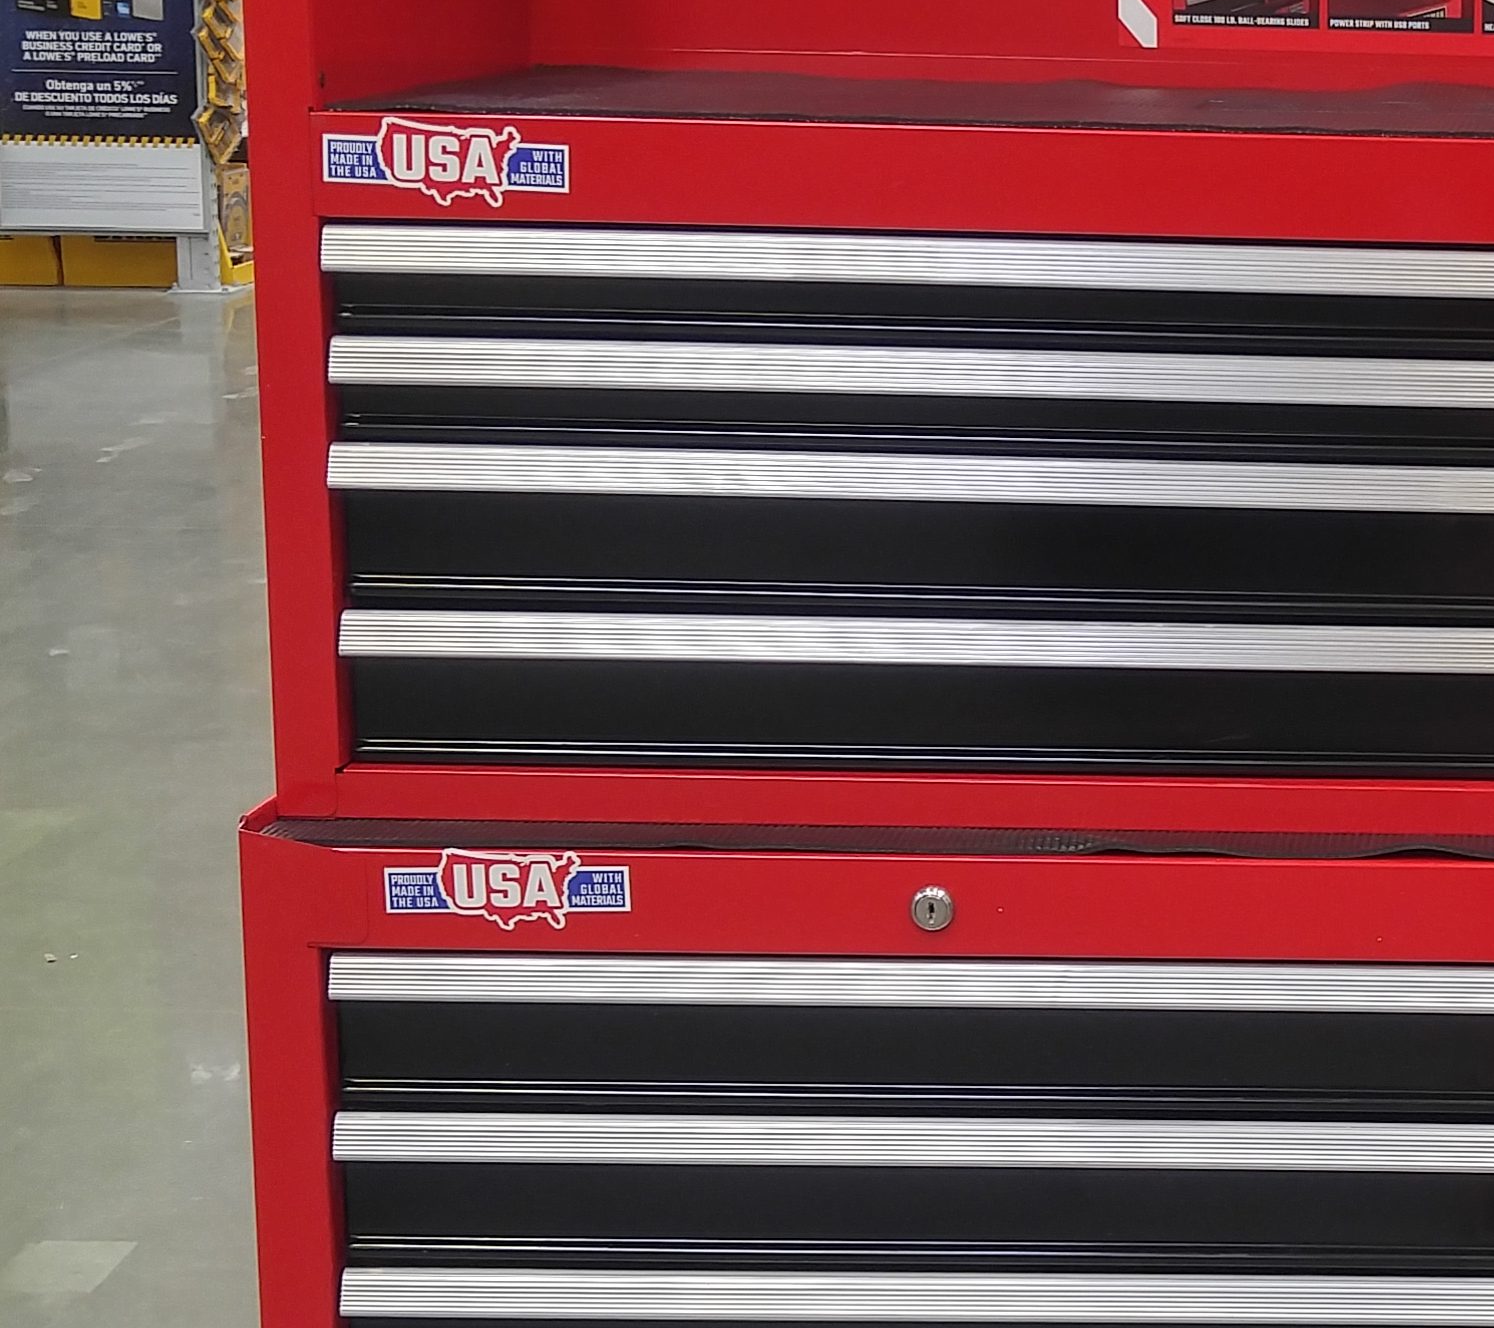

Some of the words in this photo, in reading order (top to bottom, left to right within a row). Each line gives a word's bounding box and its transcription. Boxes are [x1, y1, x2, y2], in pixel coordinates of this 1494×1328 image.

[1174, 14, 1191, 23] SOFT
[1192, 15, 1213, 24] CLOSE
[1238, 16, 1285, 26] BALL-BEARING
[1286, 18, 1310, 27] SLIDES
[1329, 18, 1354, 28] POWER
[1355, 19, 1374, 28] STRIP
[1375, 19, 1393, 29] WITH
[1408, 21, 1430, 30] PORTS
[26, 30, 57, 41] WHEN
[58, 31, 79, 41] YOU
[81, 31, 102, 41] USE
[21, 41, 73, 51] BUSINESS
[75, 42, 112, 52] CREDIT
[147, 43, 162, 53] OR
[77, 52, 125, 62] PRELOAD
[45, 79, 94, 92] Obtenga
[96, 82, 111, 91] un
[15, 92, 30, 102] DE
[31, 92, 92, 103] DESCUENTO
[93, 93, 129, 104] TODOS
[130, 94, 151, 104] LOS
[152, 91, 178, 104] DÍAS
[330, 141, 373, 154] PROUDLY
[330, 154, 359, 166] MADE
[361, 154, 373, 166] IN
[393, 134, 500, 184] USA
[532, 150, 563, 163] WITH
[330, 165, 351, 177] THE
[354, 166, 377, 178] USA
[519, 162, 563, 174] GLOBAL
[510, 173, 563, 186] MATERIALS
[391, 874, 434, 886] PROUDLY
[592, 872, 622, 883] WITH
[391, 885, 421, 897] MADE
[423, 885, 434, 896] IN
[453, 864, 561, 908] USA
[580, 883, 623, 895] GLOBAL
[392, 897, 413, 908] THE
[416, 897, 439, 908] USA
[571, 895, 624, 906] MATERIALS
